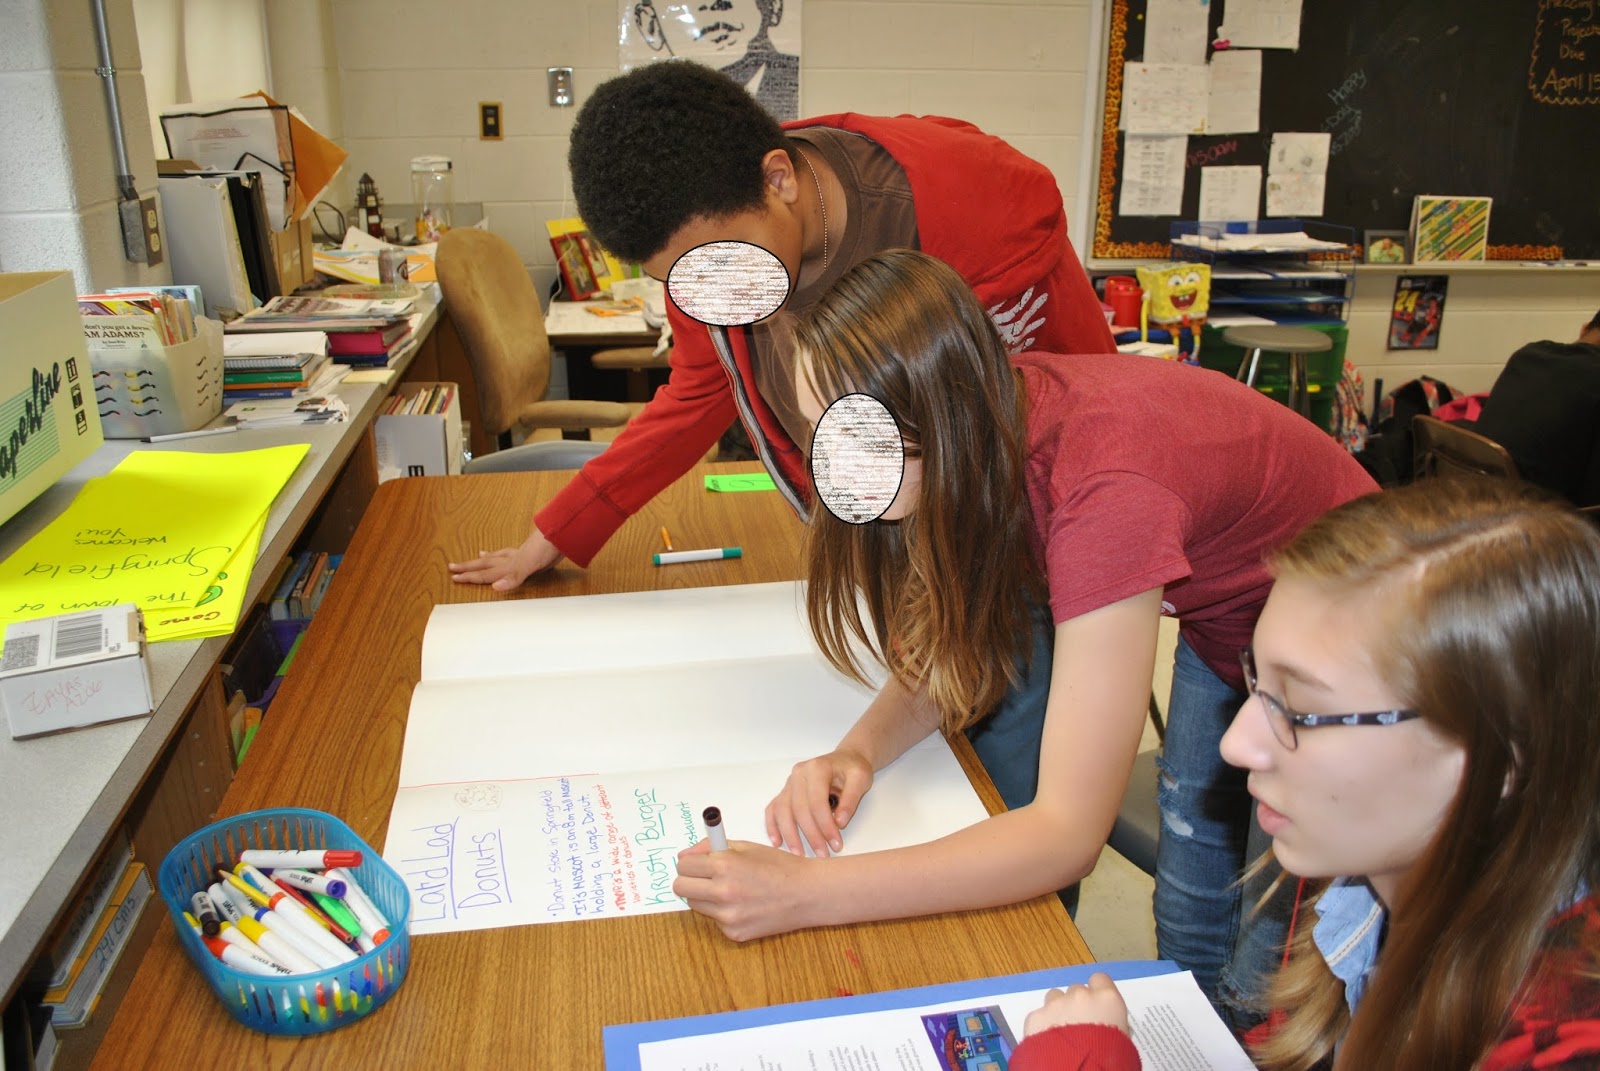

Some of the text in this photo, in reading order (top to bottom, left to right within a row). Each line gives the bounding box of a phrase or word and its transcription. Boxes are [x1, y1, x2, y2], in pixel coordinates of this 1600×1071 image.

[1560, 44, 1585, 61] Due
[1327, 69, 1368, 105] Happy
[1541, 67, 1584, 95] April
[1394, 289, 1420, 314] 24
[103, 331, 145, 339] ADAMS?
[0, 362, 62, 479] aperline
[75, 535, 167, 546] Welcomes
[24, 546, 232, 580] Springfield
[14, 603, 45, 613] of
[147, 591, 192, 603] The
[539, 789, 561, 835] Springfield
[562, 798, 574, 812] tall
[600, 811, 614, 821] of
[634, 788, 667, 846] Burger
[606, 822, 619, 844] range
[674, 801, 698, 849] estaurant
[549, 837, 560, 847] in
[568, 842, 579, 853] is
[585, 825, 604, 855] large
[591, 860, 602, 869] a
[608, 846, 621, 866] wide
[400, 823, 453, 923] Lard Lad
[457, 832, 502, 909] Donuts
[619, 835, 642, 904] varieties of donuts
[546, 878, 565, 912] Donut
[589, 872, 614, 914] holding
